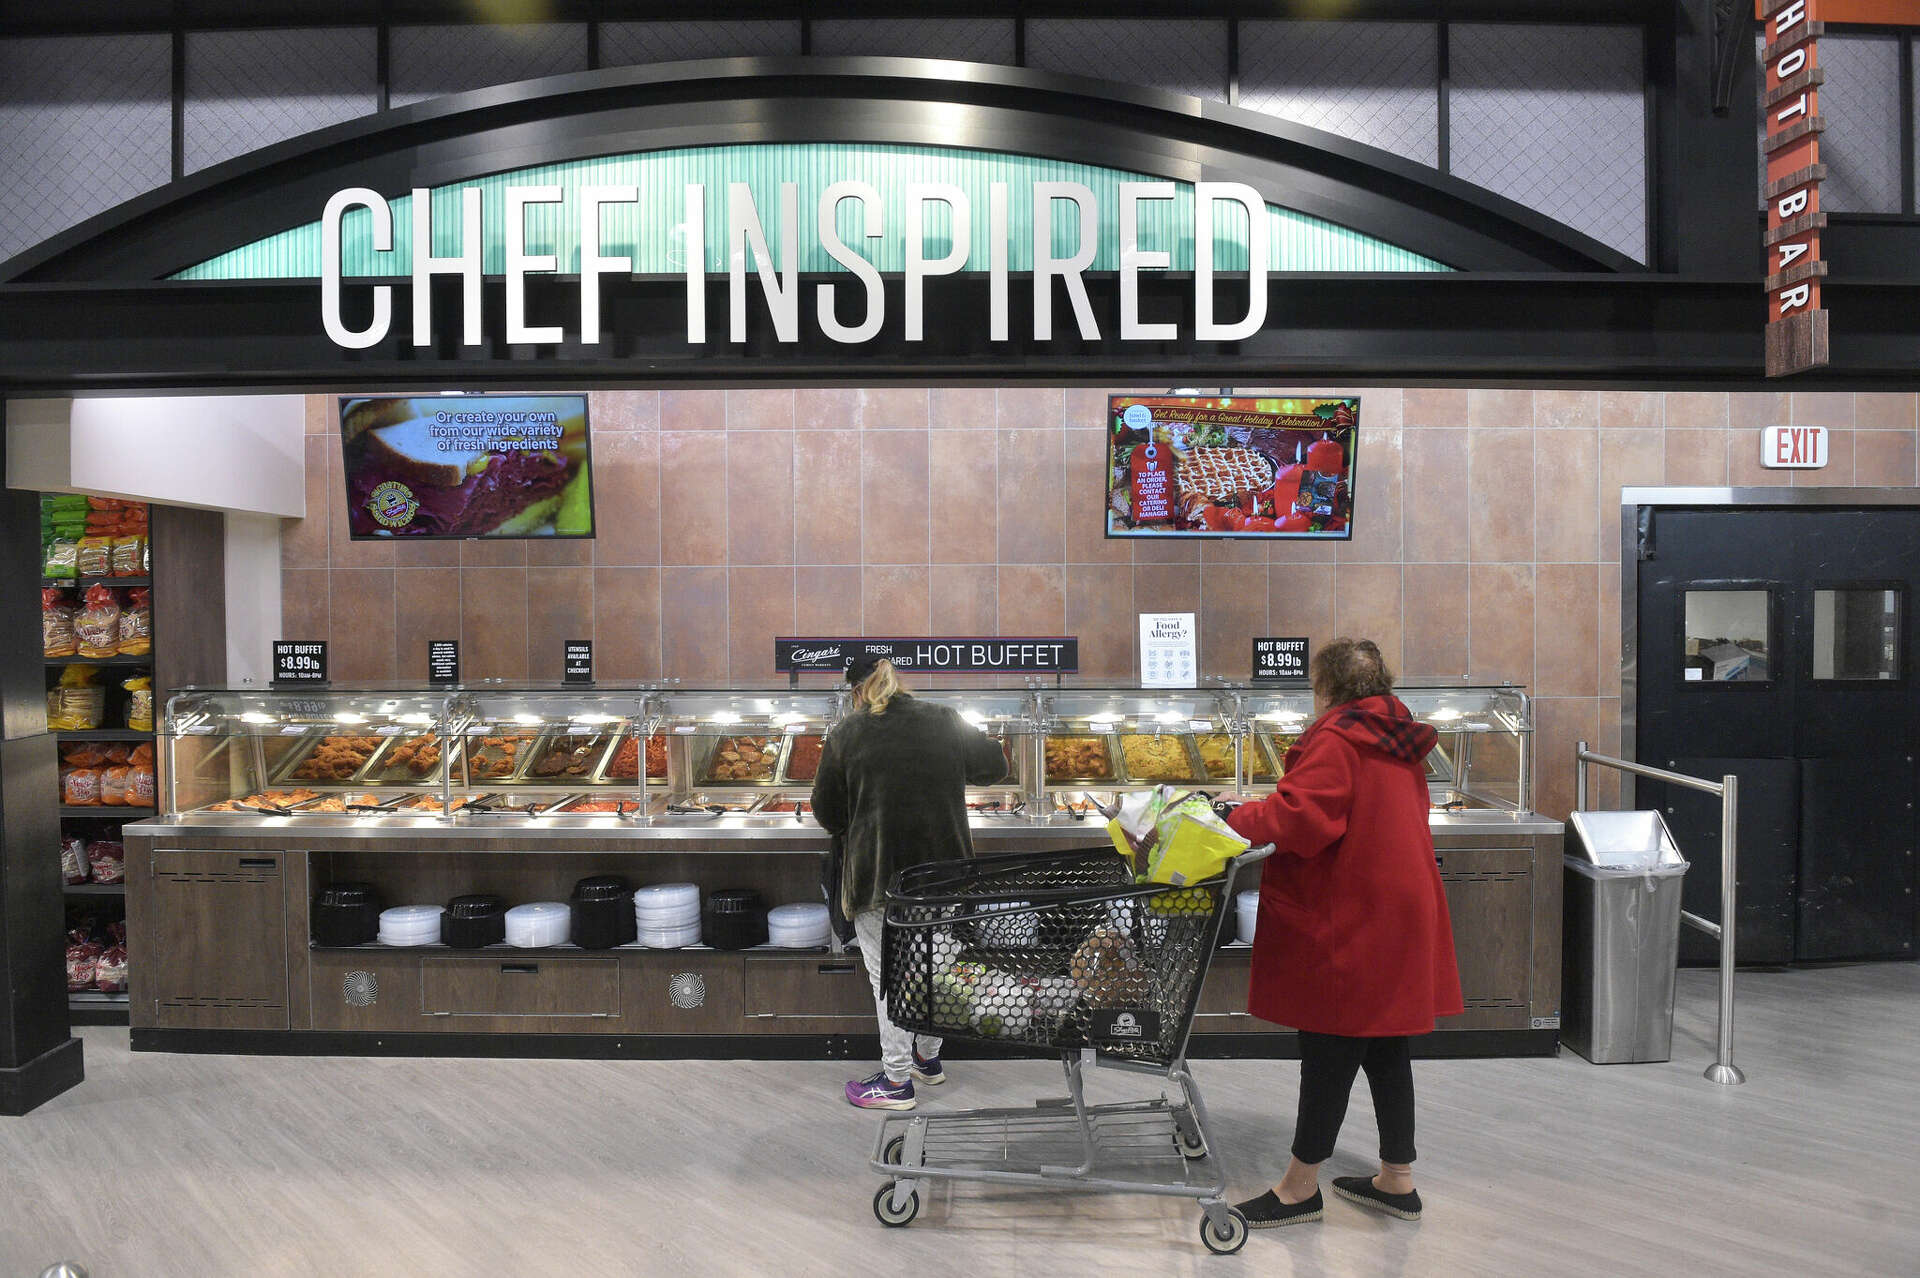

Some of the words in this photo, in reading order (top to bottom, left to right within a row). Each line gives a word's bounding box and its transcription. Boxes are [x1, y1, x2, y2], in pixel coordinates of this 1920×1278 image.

[1776, 0, 1806, 122] HOT
[1778, 188, 1810, 314] BAR
[321, 184, 639, 349] CHEF
[686, 180, 1268, 343] INSPIRED
[436, 411, 452, 423] Or
[455, 411, 493, 423] create
[497, 412, 526, 425] your
[529, 412, 556, 423] own
[1153, 409, 1168, 419] Get
[1169, 409, 1194, 423] Ready
[1194, 411, 1209, 424] for
[1209, 413, 1217, 422] a
[1218, 412, 1242, 423] Great
[1242, 415, 1275, 428] Holiday
[1276, 416, 1326, 427] Celebration!
[430, 425, 459, 437] from
[462, 426, 483, 437] our
[487, 424, 517, 436] wide
[520, 424, 564, 438] variety
[437, 438, 453, 451] of
[454, 438, 485, 450] fresh
[488, 438, 559, 452] ingredients
[1777, 428, 1820, 463] EXIT
[1138, 487, 1167, 495] CONTACT
[1156, 621, 1180, 630] Food
[1149, 629, 1188, 641] Allergy?
[277, 645, 293, 654] HOT
[294, 645, 322, 654] BUFFET
[865, 645, 893, 655] FRESH
[1257, 641, 1274, 651] HOT
[1275, 641, 1304, 651] BUFFET
[791, 644, 841, 663] Cingari
[916, 644, 965, 666] HOT
[971, 644, 1064, 666] BUFFET
